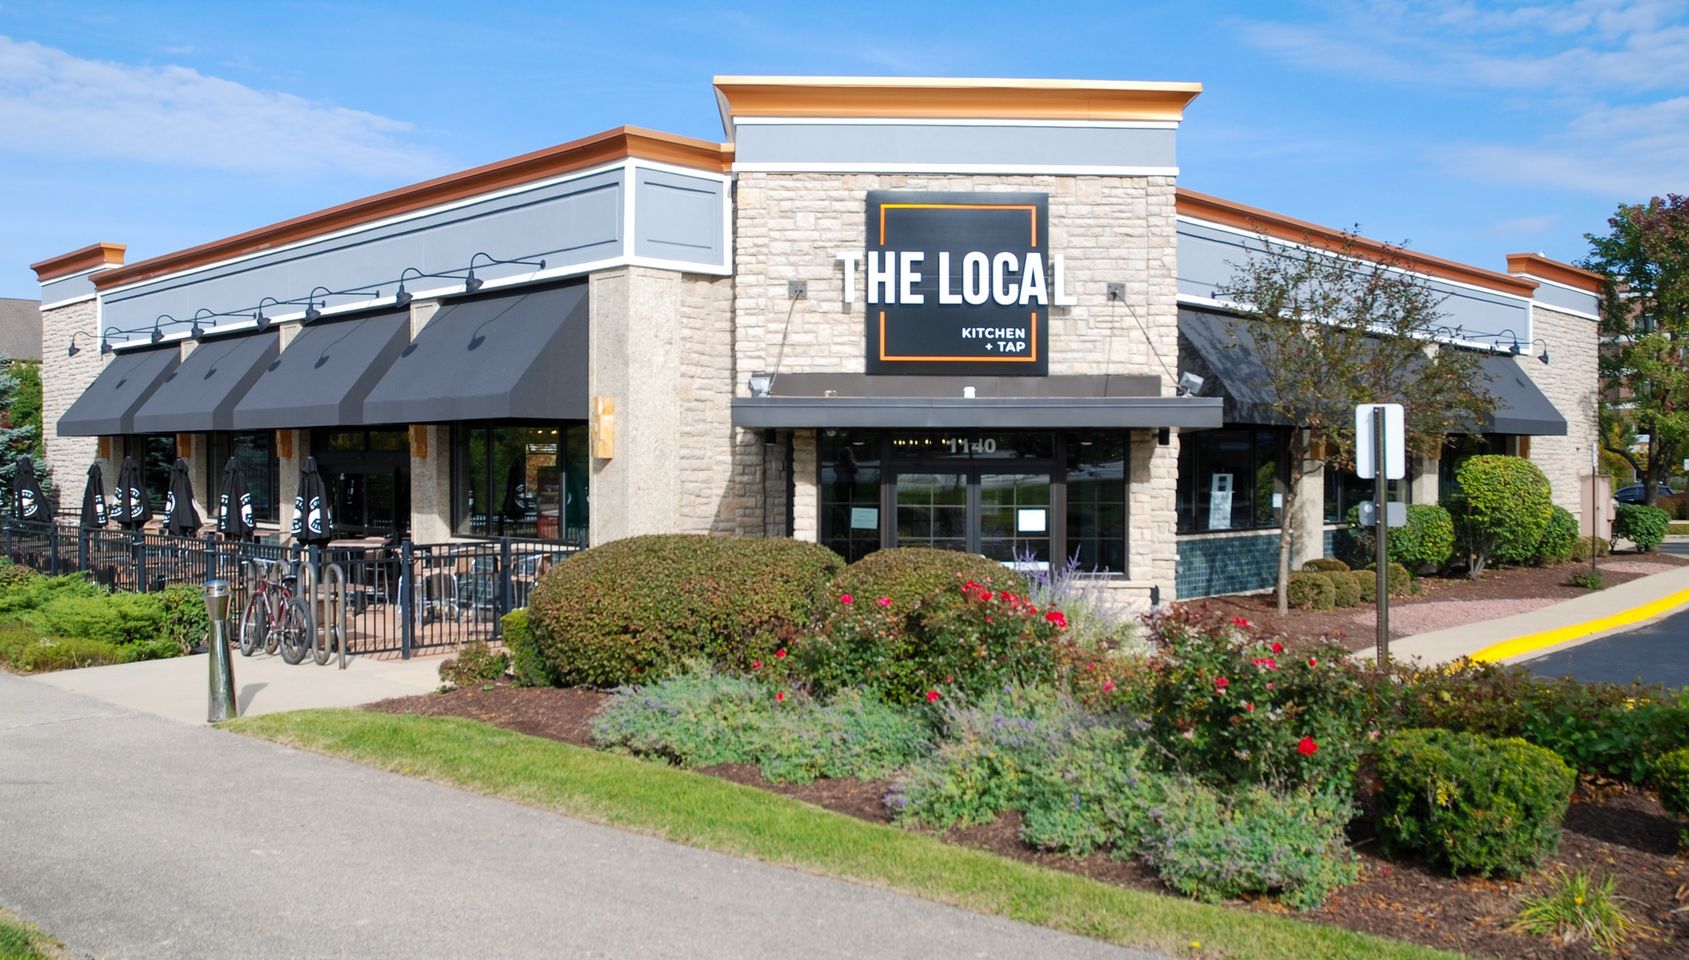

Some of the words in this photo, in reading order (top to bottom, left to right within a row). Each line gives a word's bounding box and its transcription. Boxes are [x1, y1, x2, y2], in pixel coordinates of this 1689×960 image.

[836, 251, 925, 305] THE
[938, 251, 1078, 306] LOCAL
[961, 327, 1026, 339] KITCHEN
[996, 341, 1026, 352] TAP
[948, 437, 997, 454] 1140
